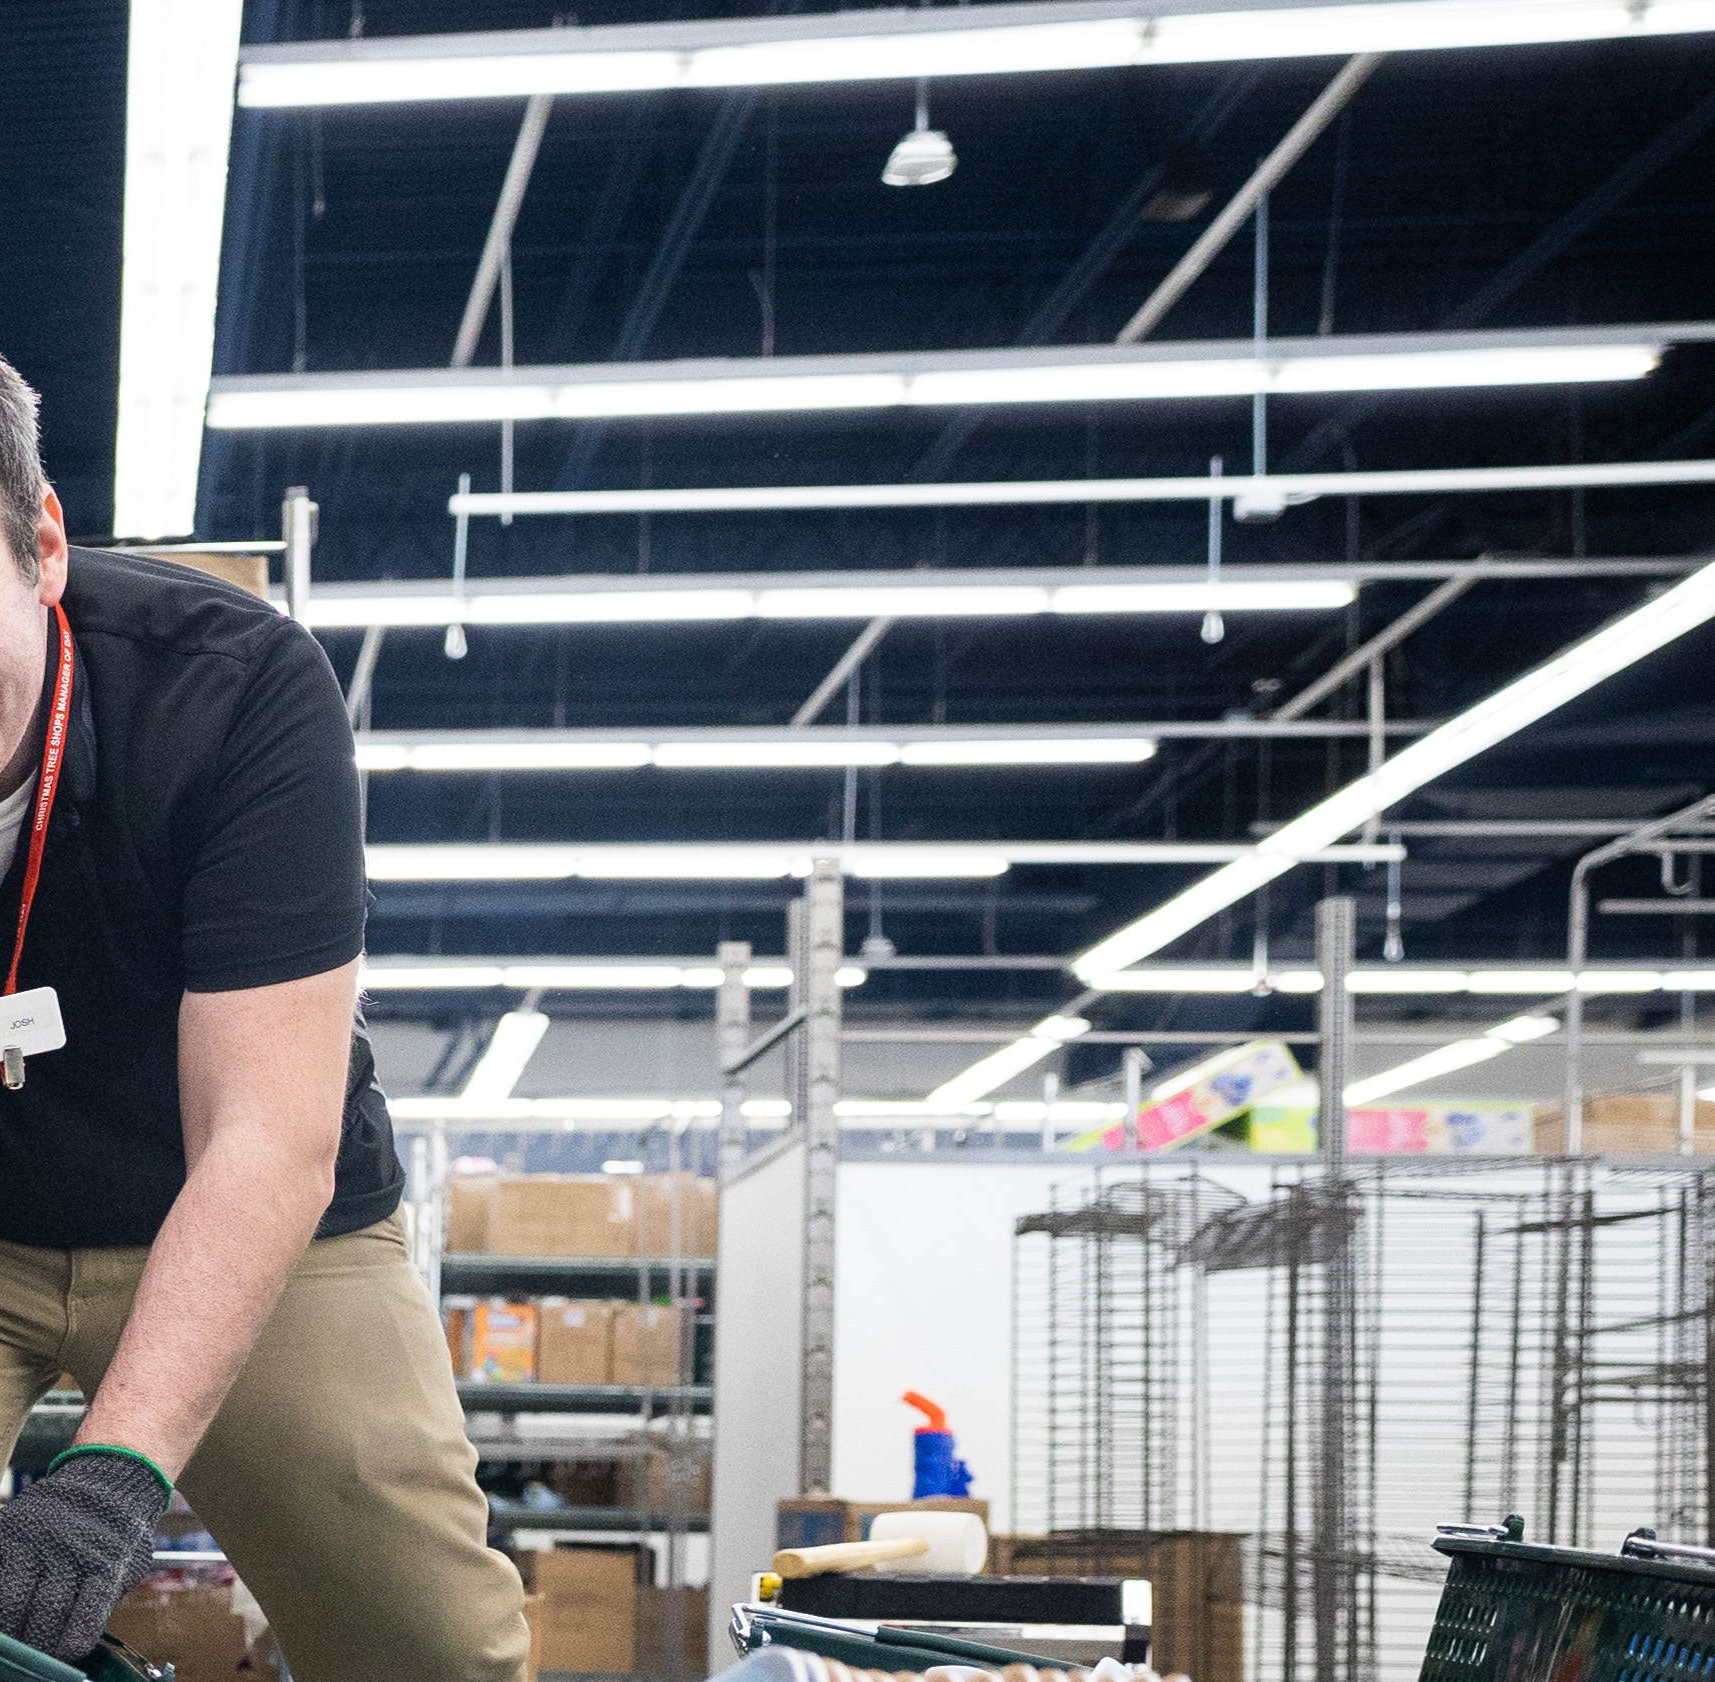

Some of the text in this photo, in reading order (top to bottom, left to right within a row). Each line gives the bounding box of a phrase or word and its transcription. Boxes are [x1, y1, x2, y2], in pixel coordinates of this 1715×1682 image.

[35, 628, 72, 831] CHRISTMAS TREE SHOPS MANAGER OF DAY
[10, 1016, 35, 1030] JOSH
